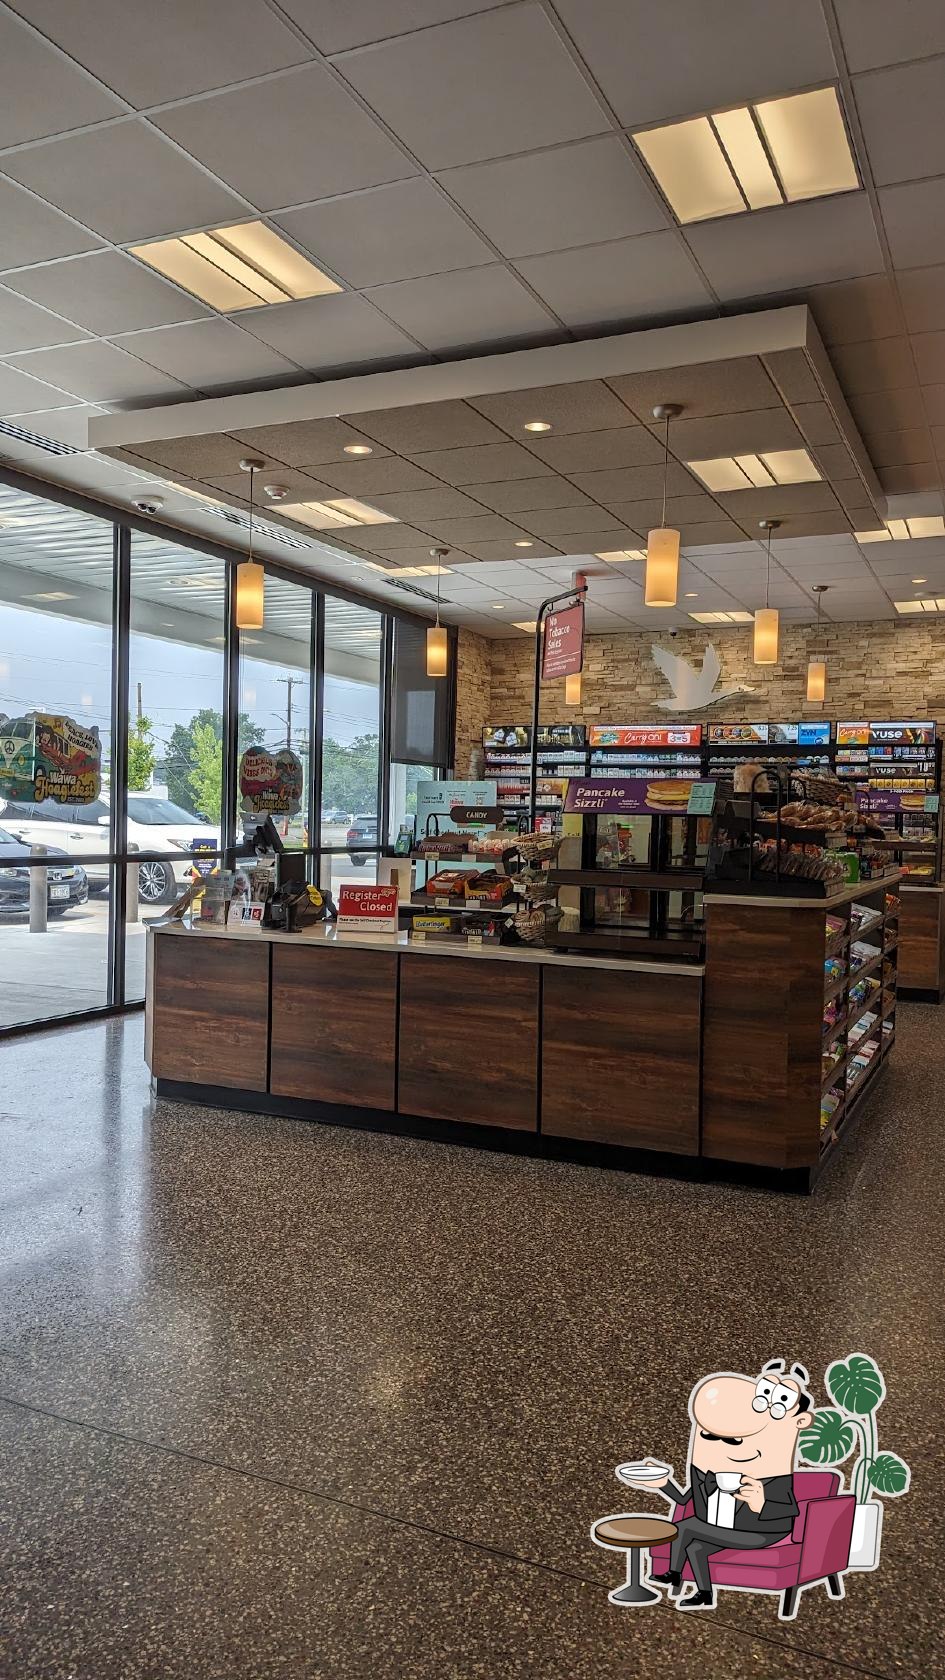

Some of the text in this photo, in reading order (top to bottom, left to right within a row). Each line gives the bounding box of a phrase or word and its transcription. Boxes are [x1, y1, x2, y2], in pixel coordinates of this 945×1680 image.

[549, 616, 557, 626] No
[549, 625, 570, 638] Tobacco
[547, 640, 562, 650] Sales
[800, 728, 817, 736] ZYN
[49, 771, 77, 784] Wawa
[35, 776, 94, 802] Hoagiefest
[576, 788, 625, 797] Pancake
[574, 798, 604, 808] Sizzli
[466, 811, 488, 819] CANDY
[342, 890, 381, 902] Register
[360, 902, 392, 911] Closed
